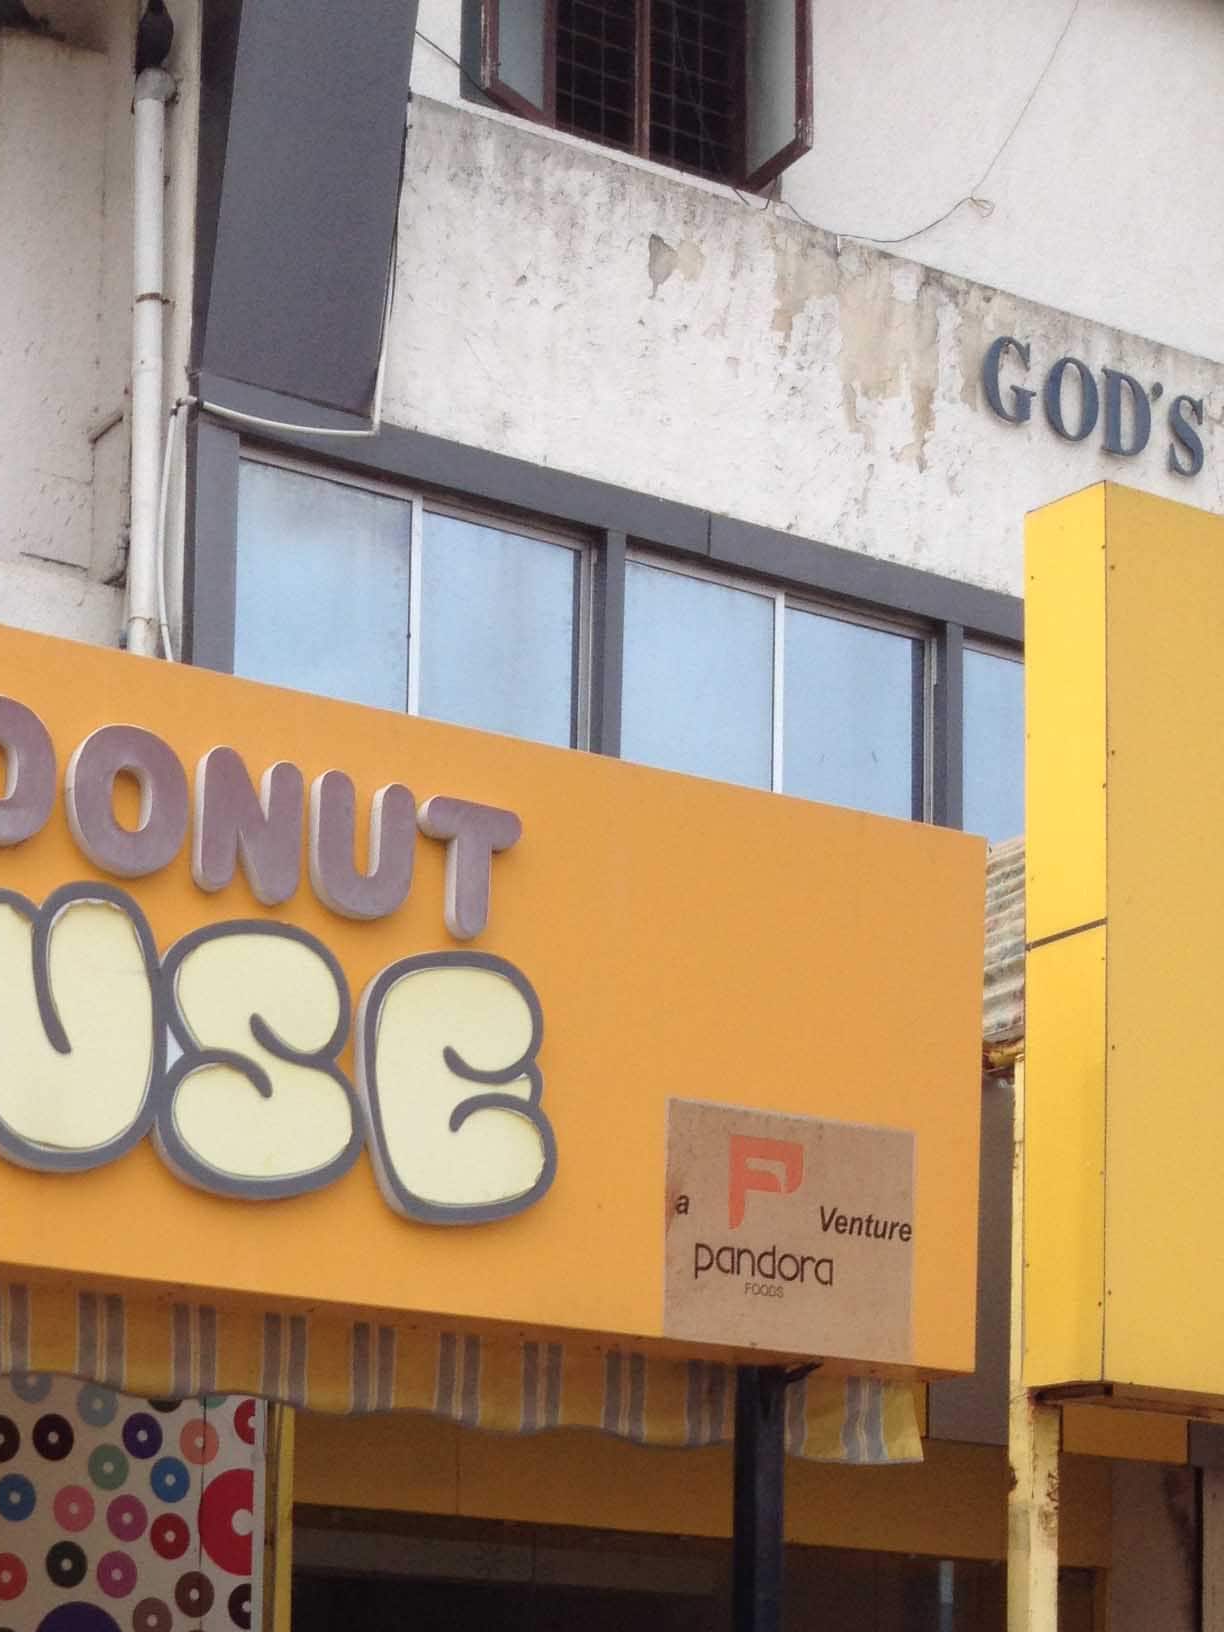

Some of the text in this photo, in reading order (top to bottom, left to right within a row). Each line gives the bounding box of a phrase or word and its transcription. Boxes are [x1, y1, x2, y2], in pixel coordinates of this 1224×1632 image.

[982, 336, 1204, 478] GOD'S
[819, 1205, 912, 1242] Venture
[694, 1243, 833, 1286] pandora
